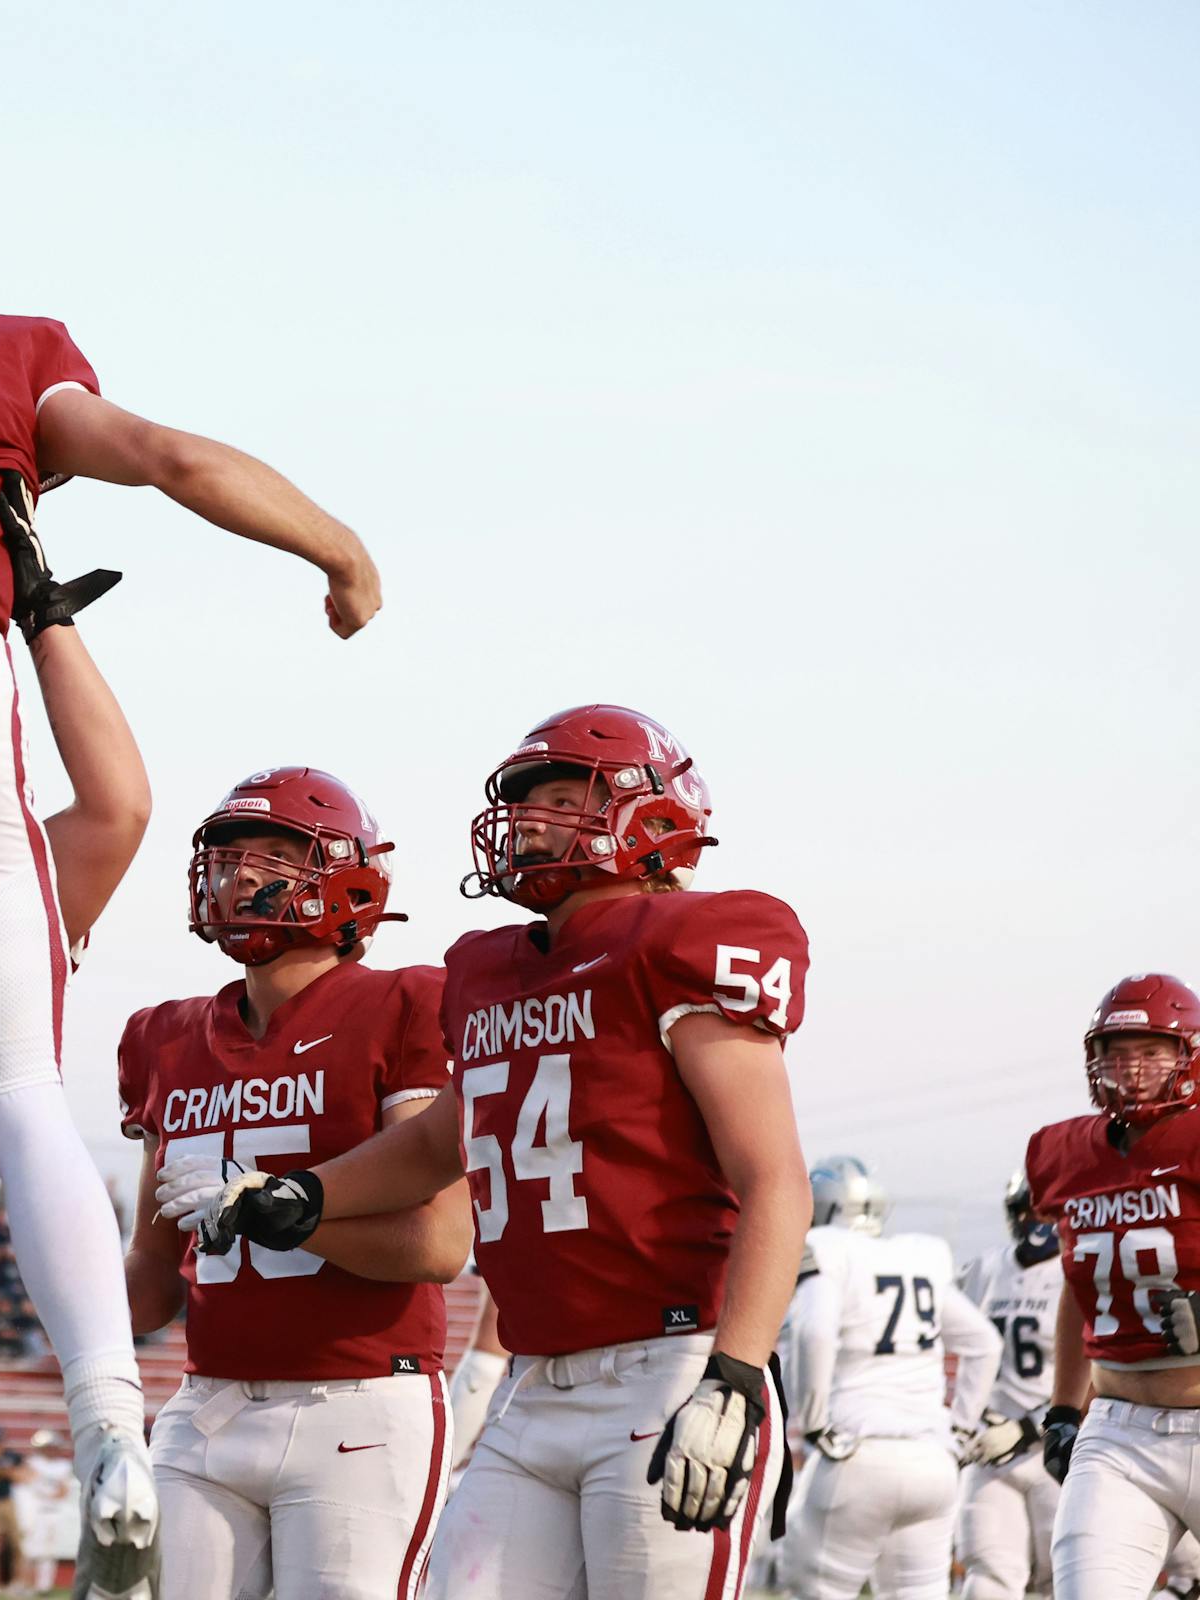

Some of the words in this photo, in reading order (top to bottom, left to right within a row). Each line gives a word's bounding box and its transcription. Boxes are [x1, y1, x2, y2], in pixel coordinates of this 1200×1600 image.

[713, 944, 792, 1029] 54
[462, 989, 596, 1062] CRIMSON
[162, 1070, 325, 1133] CRIMSON
[461, 1053, 590, 1244] 54
[1064, 1183, 1182, 1230] CRIMSON
[670, 1310, 691, 1323] XL
[874, 1275, 935, 1355] 79
[1073, 1226, 1183, 1337] 78
[398, 1359, 415, 1370] XL
